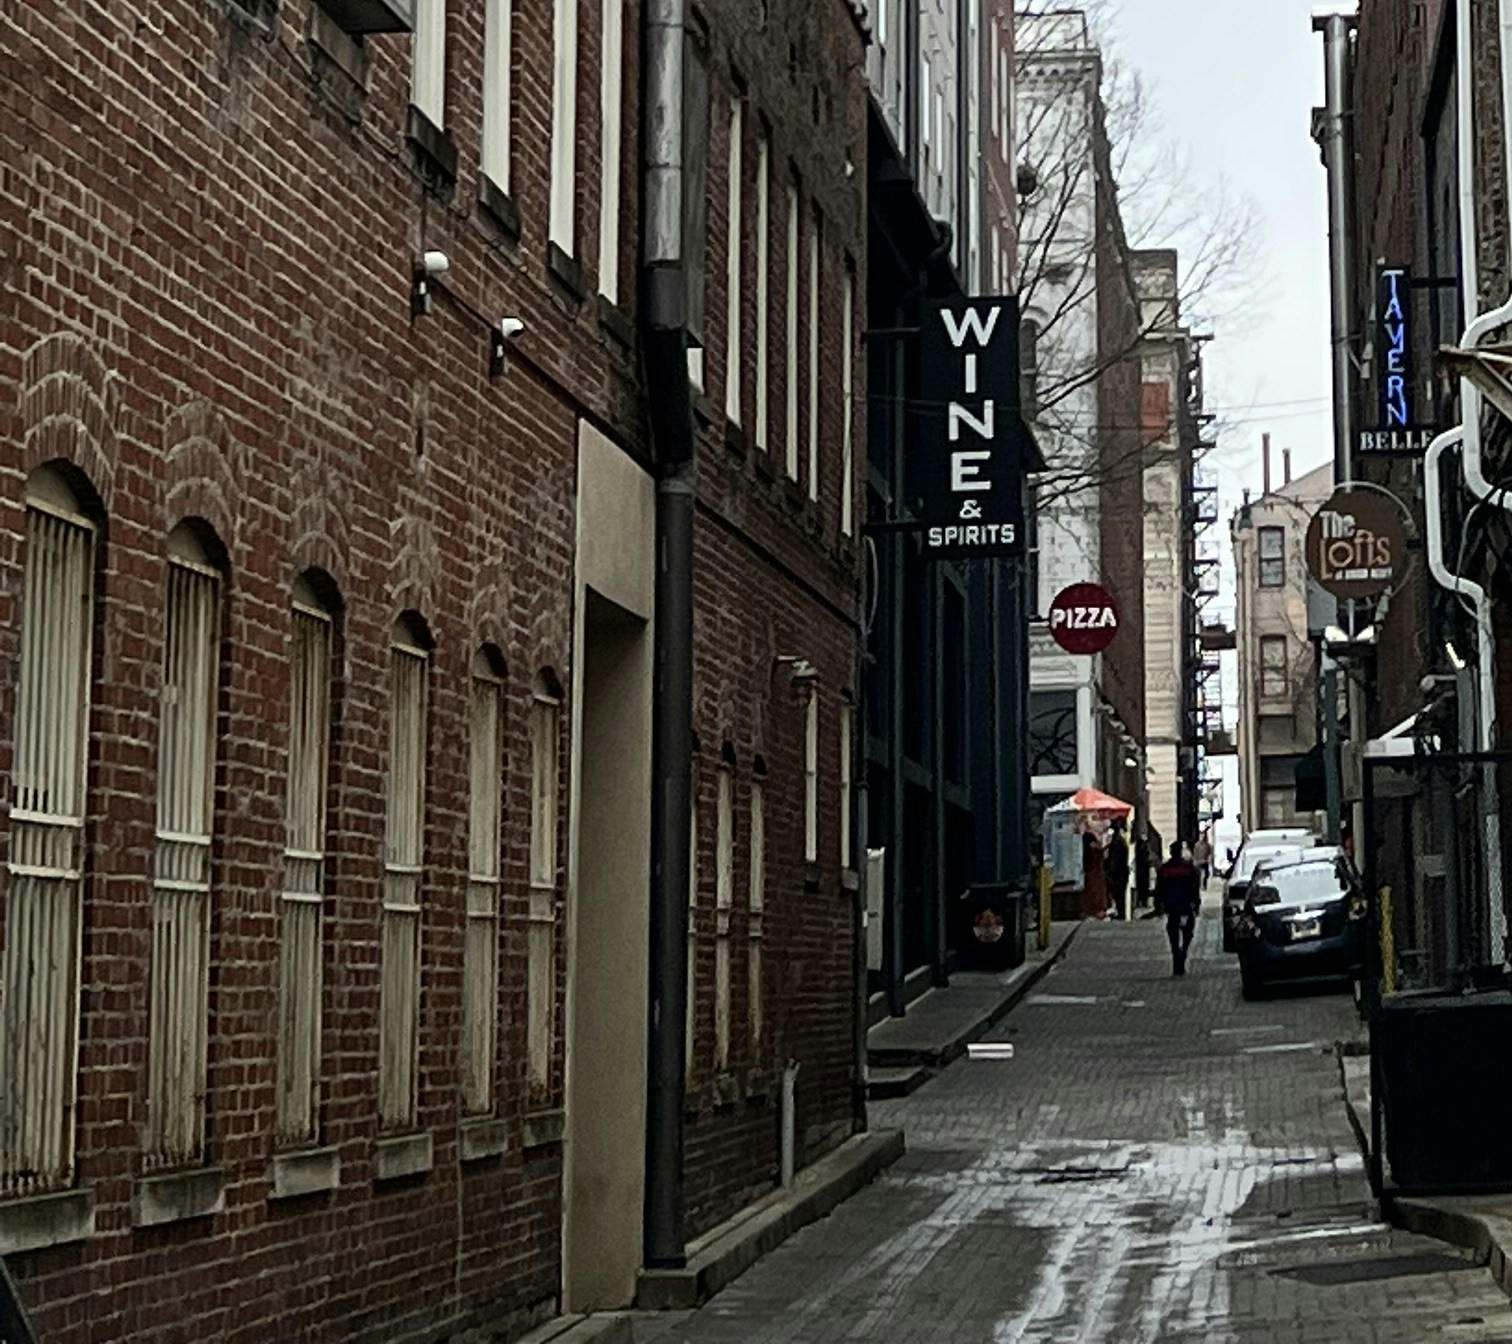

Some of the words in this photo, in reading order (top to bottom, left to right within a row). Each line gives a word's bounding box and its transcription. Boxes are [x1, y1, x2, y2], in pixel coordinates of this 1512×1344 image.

[1381, 269, 1408, 427] TAVERN
[940, 306, 1001, 492] WINE
[959, 499, 982, 519] &
[928, 524, 1015, 547] SPIRITS
[1051, 606, 1117, 629] PIZZA
